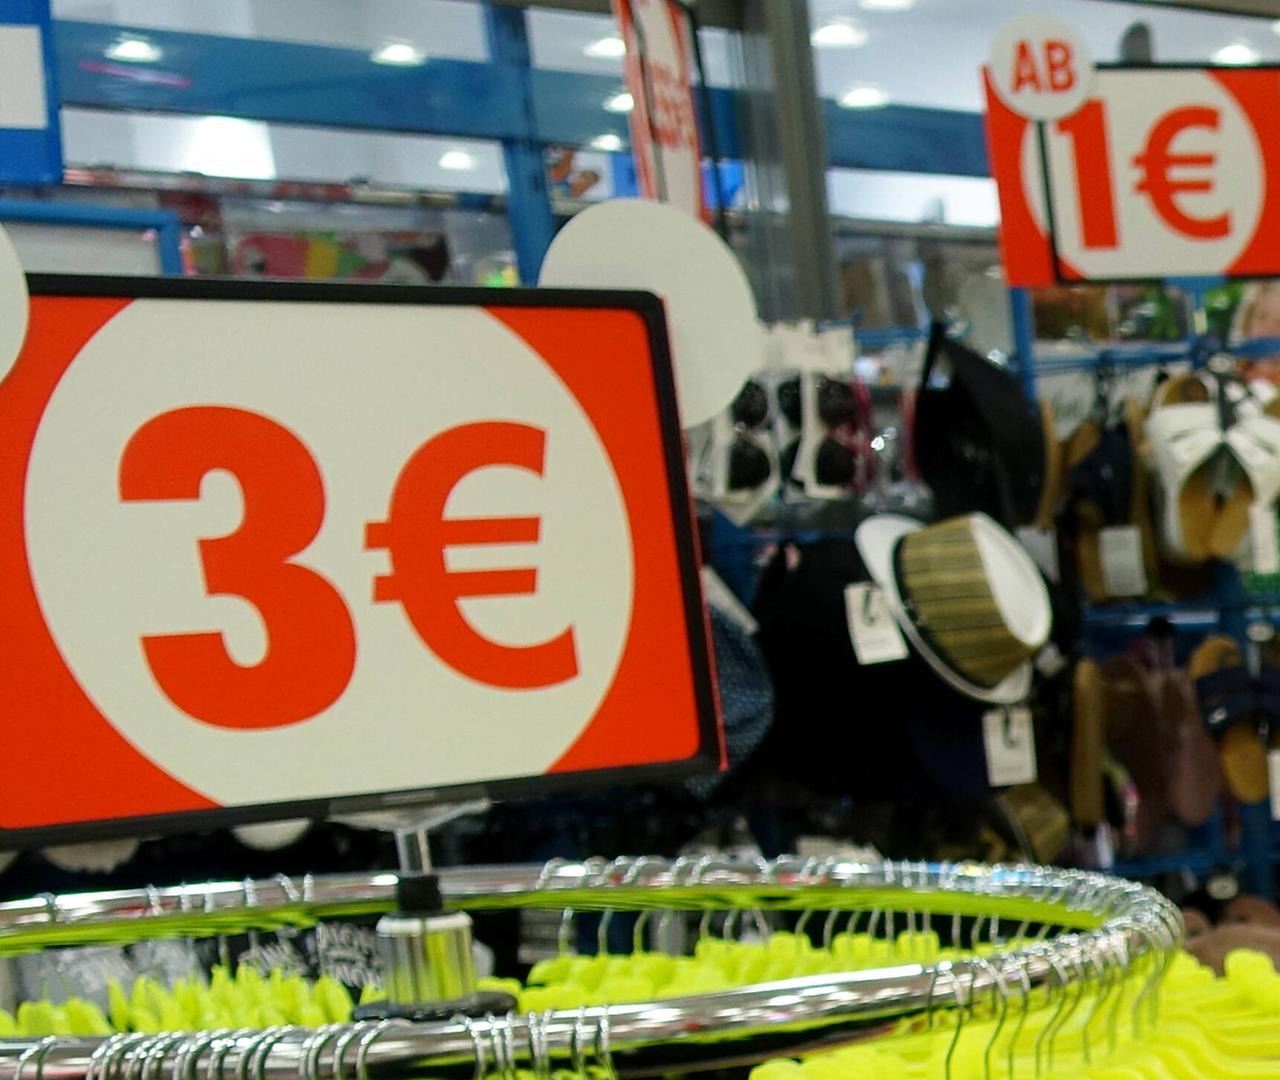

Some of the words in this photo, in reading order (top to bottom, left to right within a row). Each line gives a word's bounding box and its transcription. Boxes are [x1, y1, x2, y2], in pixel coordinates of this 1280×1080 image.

[1012, 40, 1076, 94] AB
[1055, 99, 1233, 251] 1€
[118, 404, 581, 731] 3€
